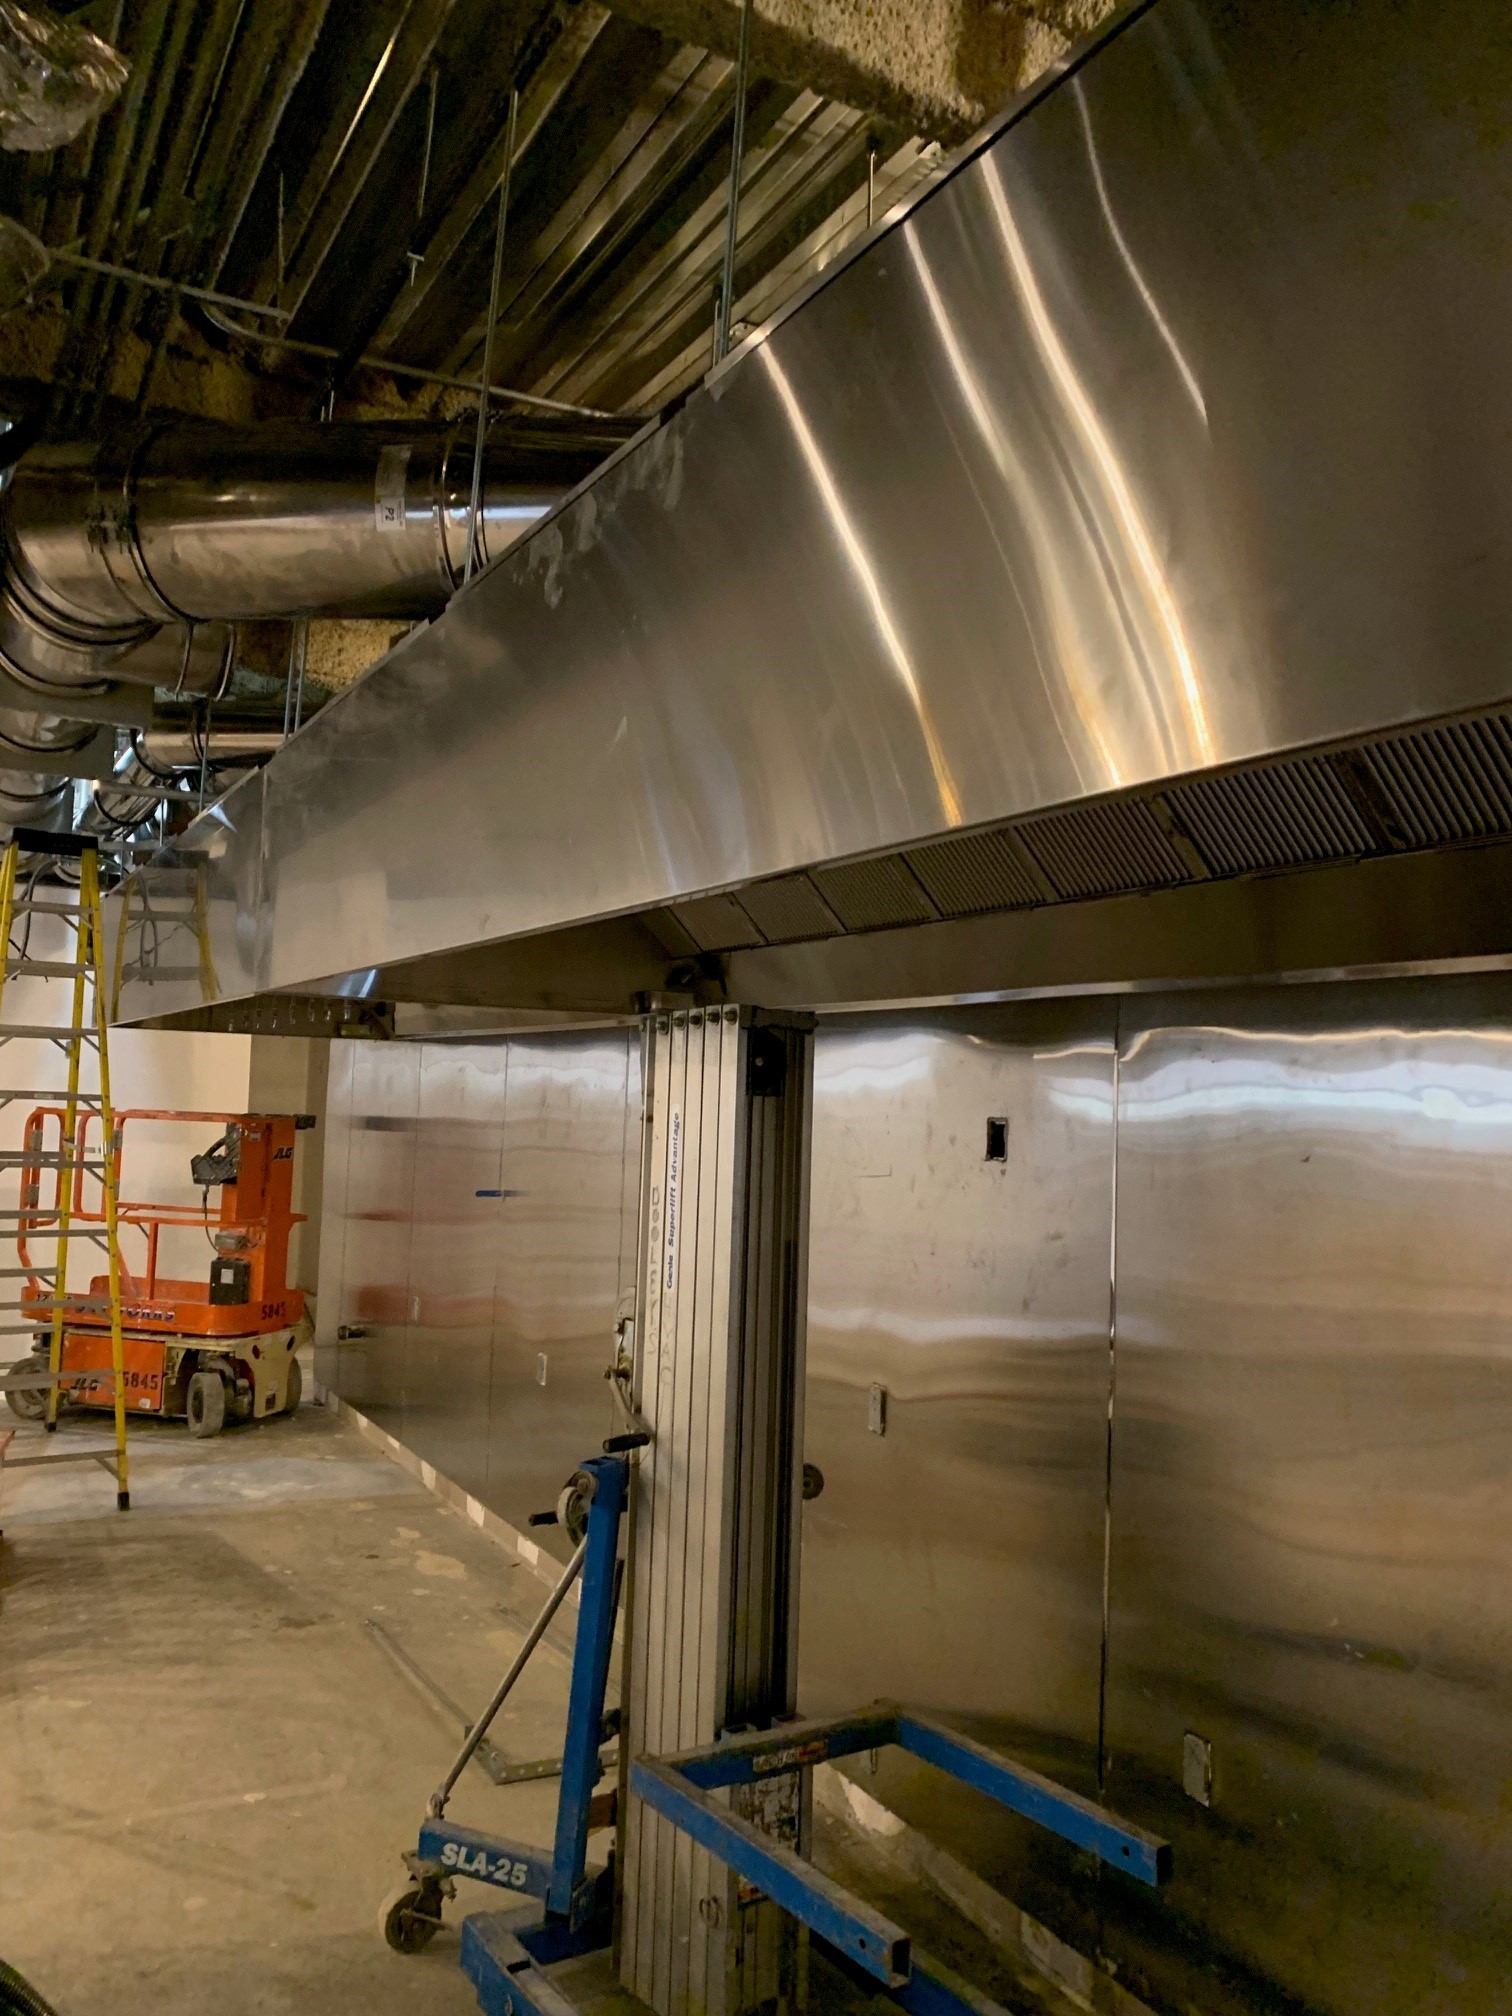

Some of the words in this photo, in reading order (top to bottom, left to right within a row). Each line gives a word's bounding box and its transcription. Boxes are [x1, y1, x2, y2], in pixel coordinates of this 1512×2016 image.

[385, 506, 395, 522] P2
[272, 1146, 295, 1161] JLG
[670, 1111, 681, 1183] Advantage
[667, 1186, 677, 1248] Superlift
[666, 1254, 674, 1290] Genie
[261, 1301, 286, 1321] 5845
[70, 1377, 99, 1391] JLG
[122, 1371, 159, 1391] 5845
[440, 1842, 528, 1887] SLA-25
